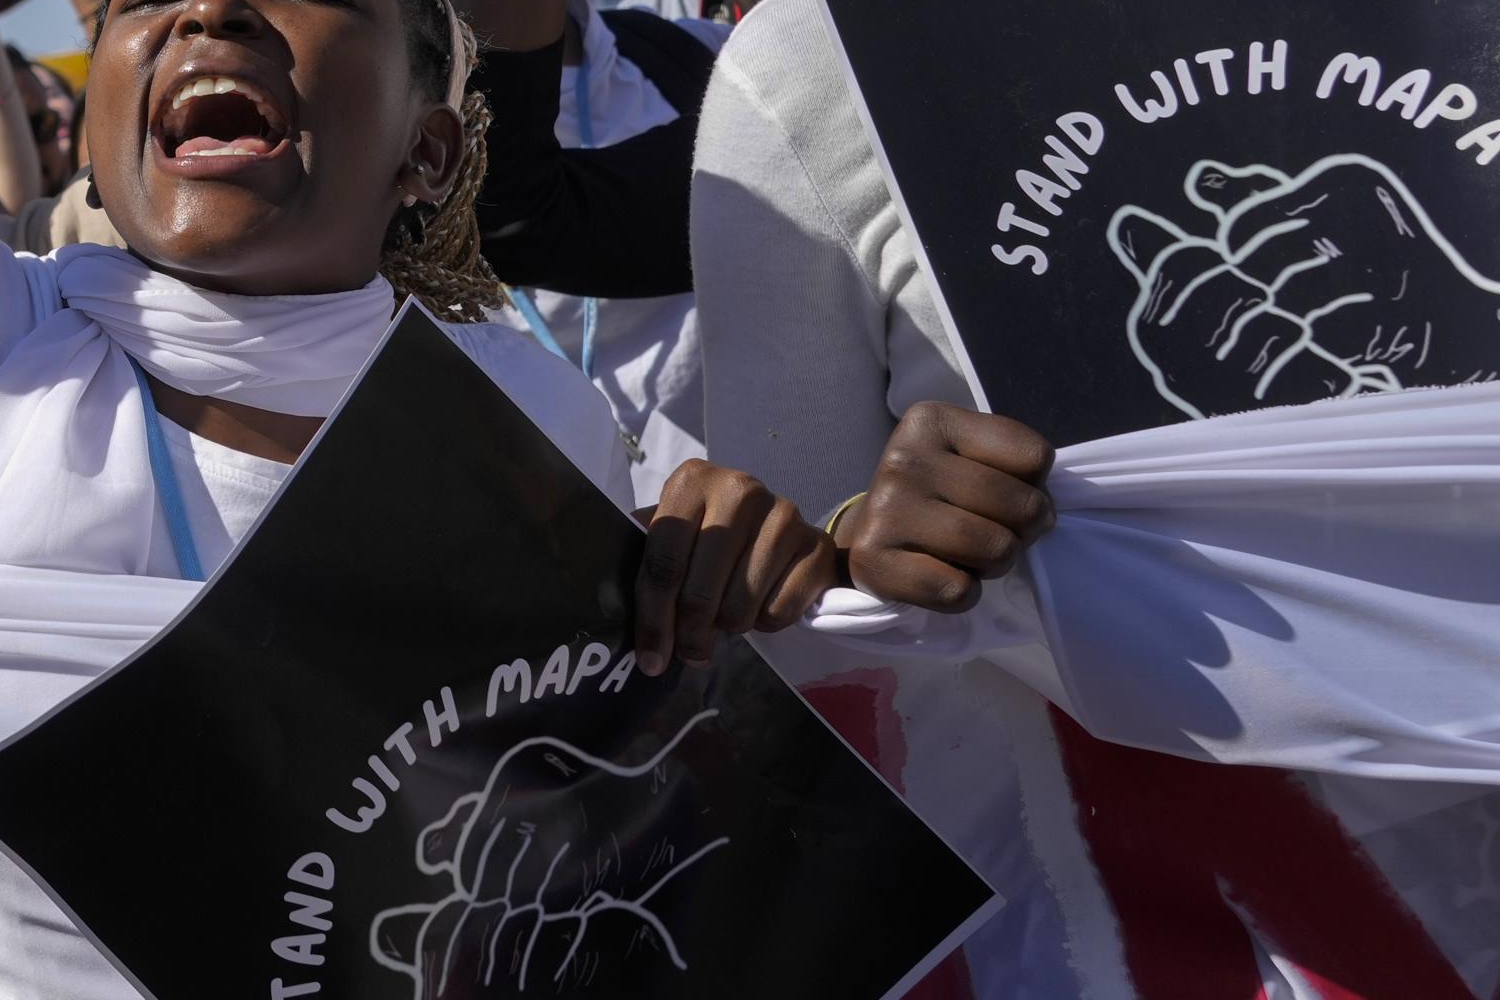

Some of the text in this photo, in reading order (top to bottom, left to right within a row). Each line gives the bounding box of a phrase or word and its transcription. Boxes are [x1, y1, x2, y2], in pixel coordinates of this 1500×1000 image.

[991, 39, 1500, 275] STAND WITH MAPA
[270, 642, 637, 1000] TAND WITH MAPA
